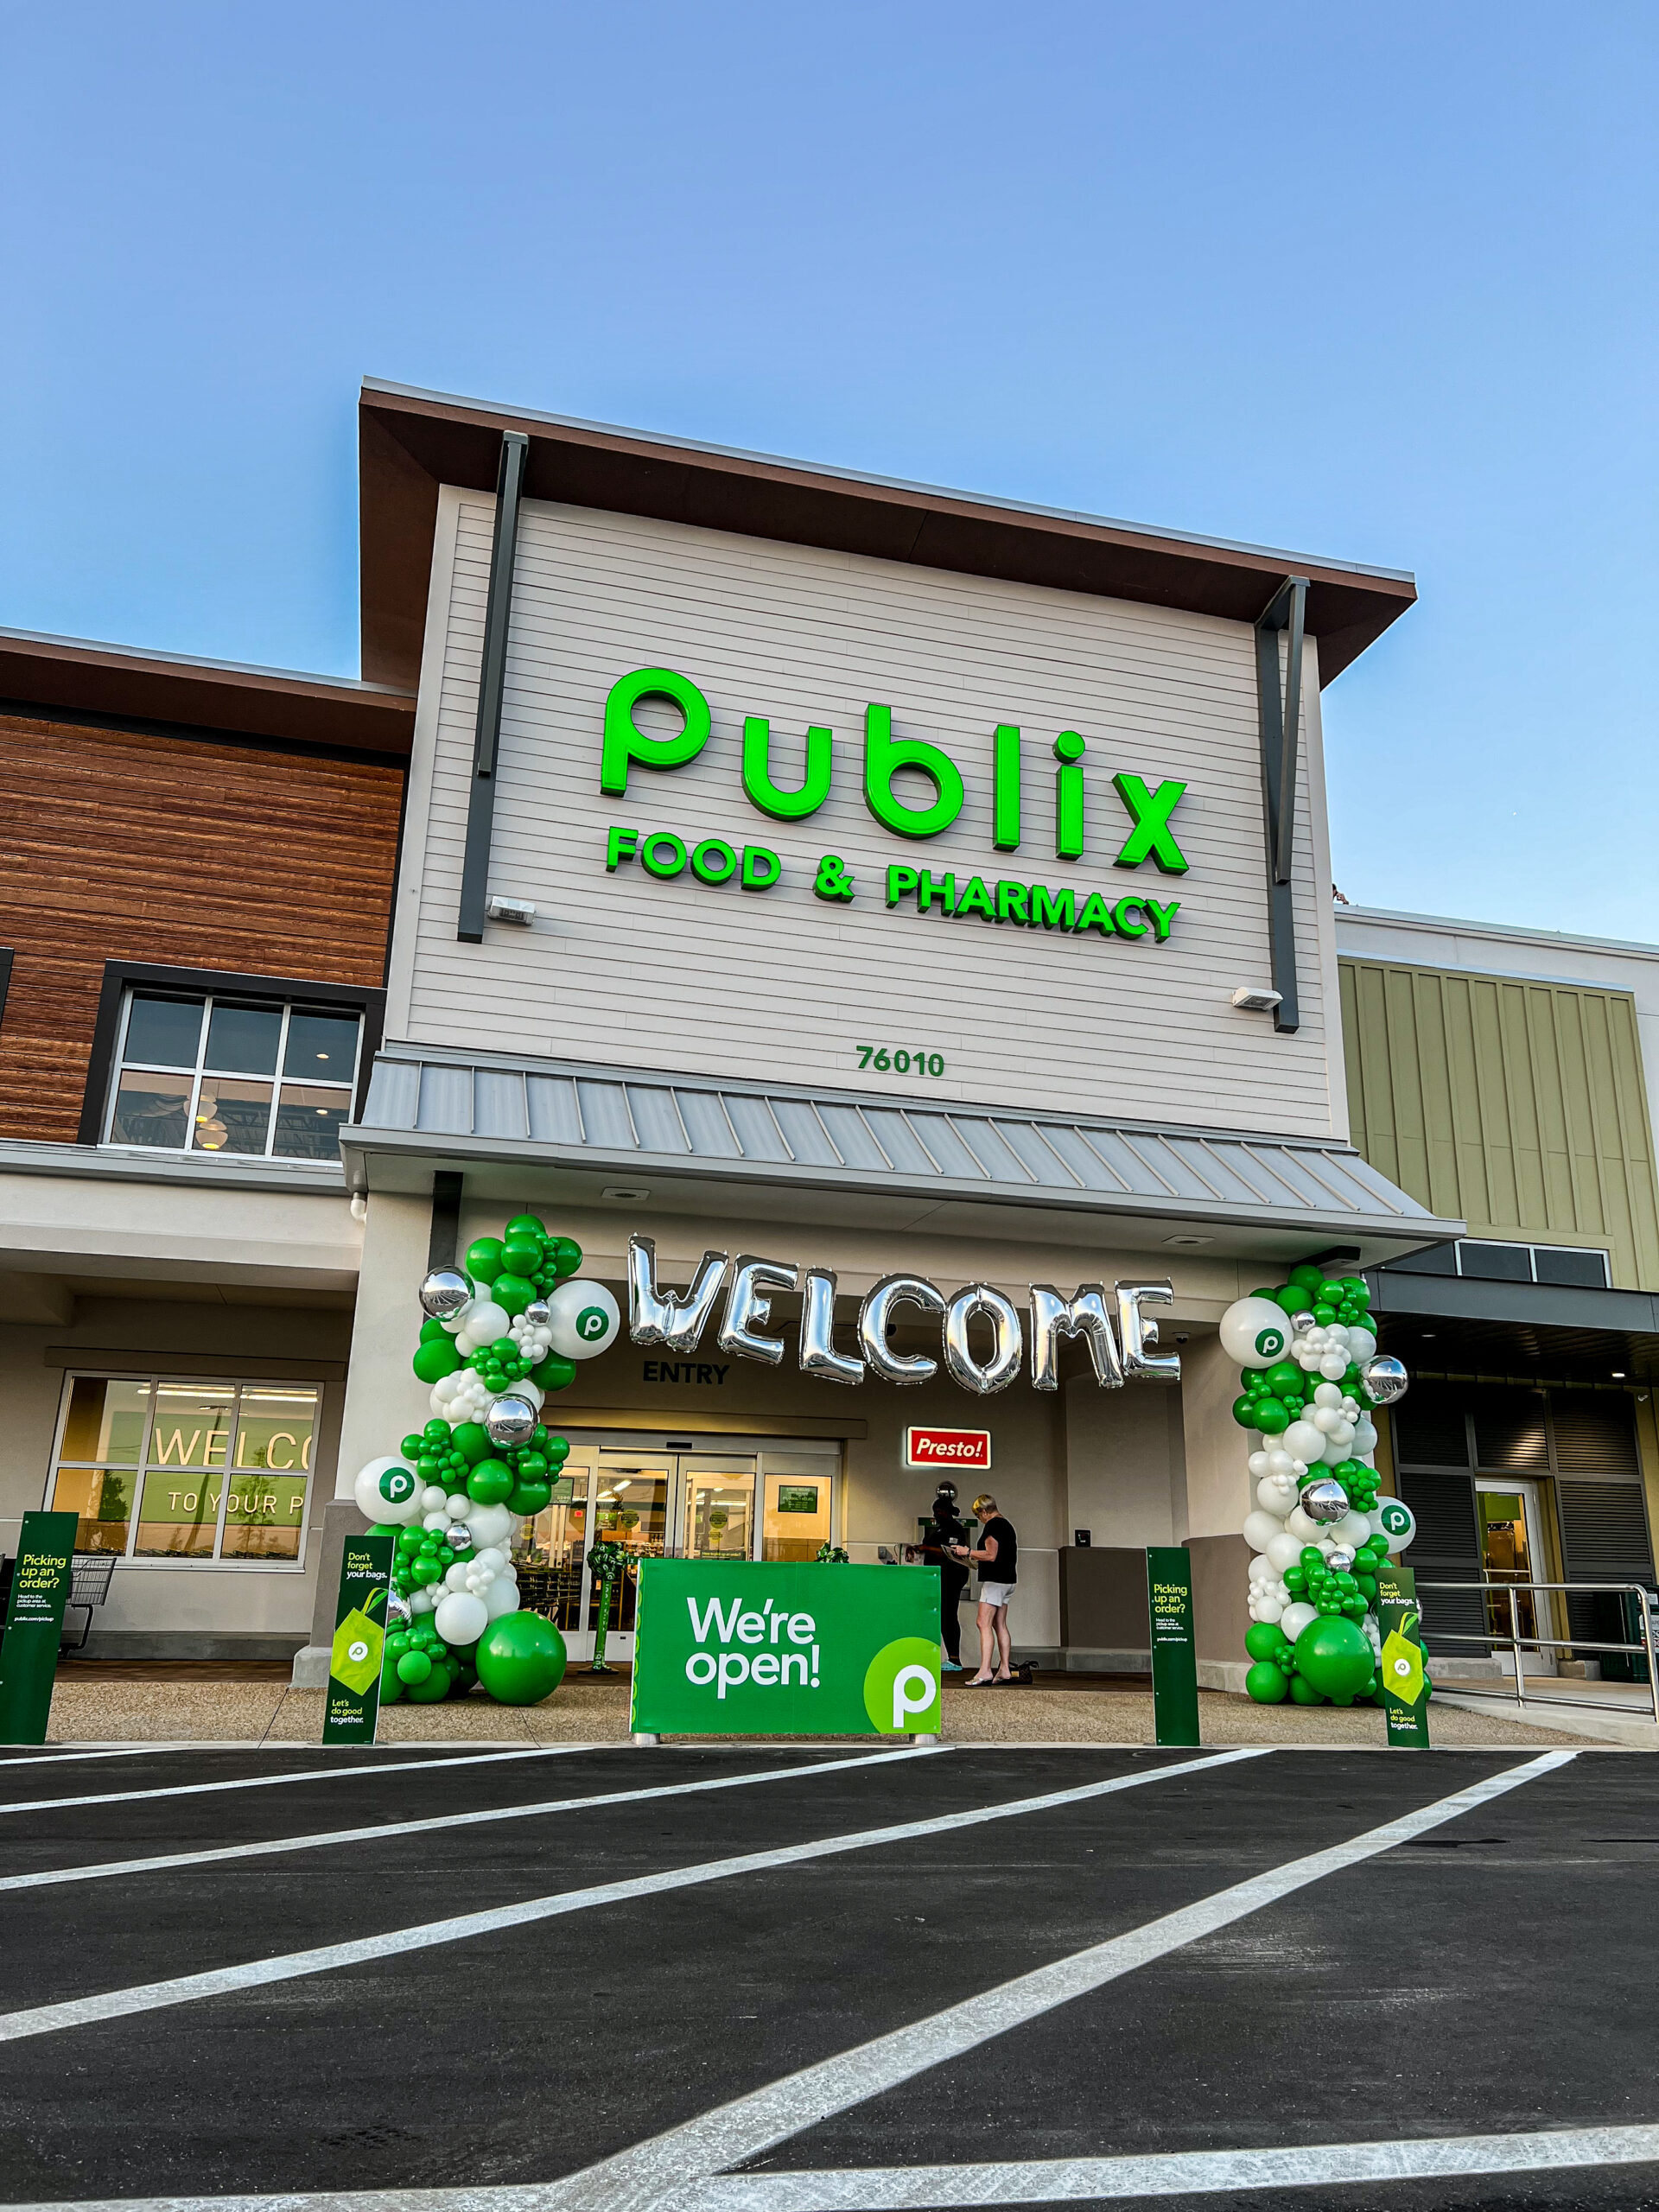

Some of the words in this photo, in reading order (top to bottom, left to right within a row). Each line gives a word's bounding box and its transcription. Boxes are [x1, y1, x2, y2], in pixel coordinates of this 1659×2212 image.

[601, 668, 1189, 875] Publix
[606, 826, 781, 891] FOOD
[813, 855, 855, 903] &
[885, 864, 1181, 944] PHARMACY
[856, 1046, 944, 1077] 76010
[627, 1232, 1181, 1394] WELCOME
[643, 1360, 730, 1385] ENTRY
[916, 1438, 983, 1458] Presto!
[168, 1492, 197, 1511] TO
[210, 1493, 276, 1513] YOUR
[22, 1554, 67, 1569] Picking
[347, 1561, 373, 1571] forget
[21, 1567, 38, 1579] up
[39, 1567, 54, 1576] an
[346, 1571, 365, 1580] your
[365, 1570, 387, 1580] bags.
[19, 1577, 60, 1588] order?
[1154, 1584, 1187, 1597] Picking
[1154, 1596, 1167, 1605] up
[1396, 1597, 1414, 1606] bags.
[1154, 1604, 1185, 1613] order?
[686, 1597, 817, 1643] We're
[685, 1644, 820, 1700] open!
[342, 1707, 362, 1717] good
[330, 1716, 364, 1725] together.
[1391, 1722, 1418, 1731] together.
